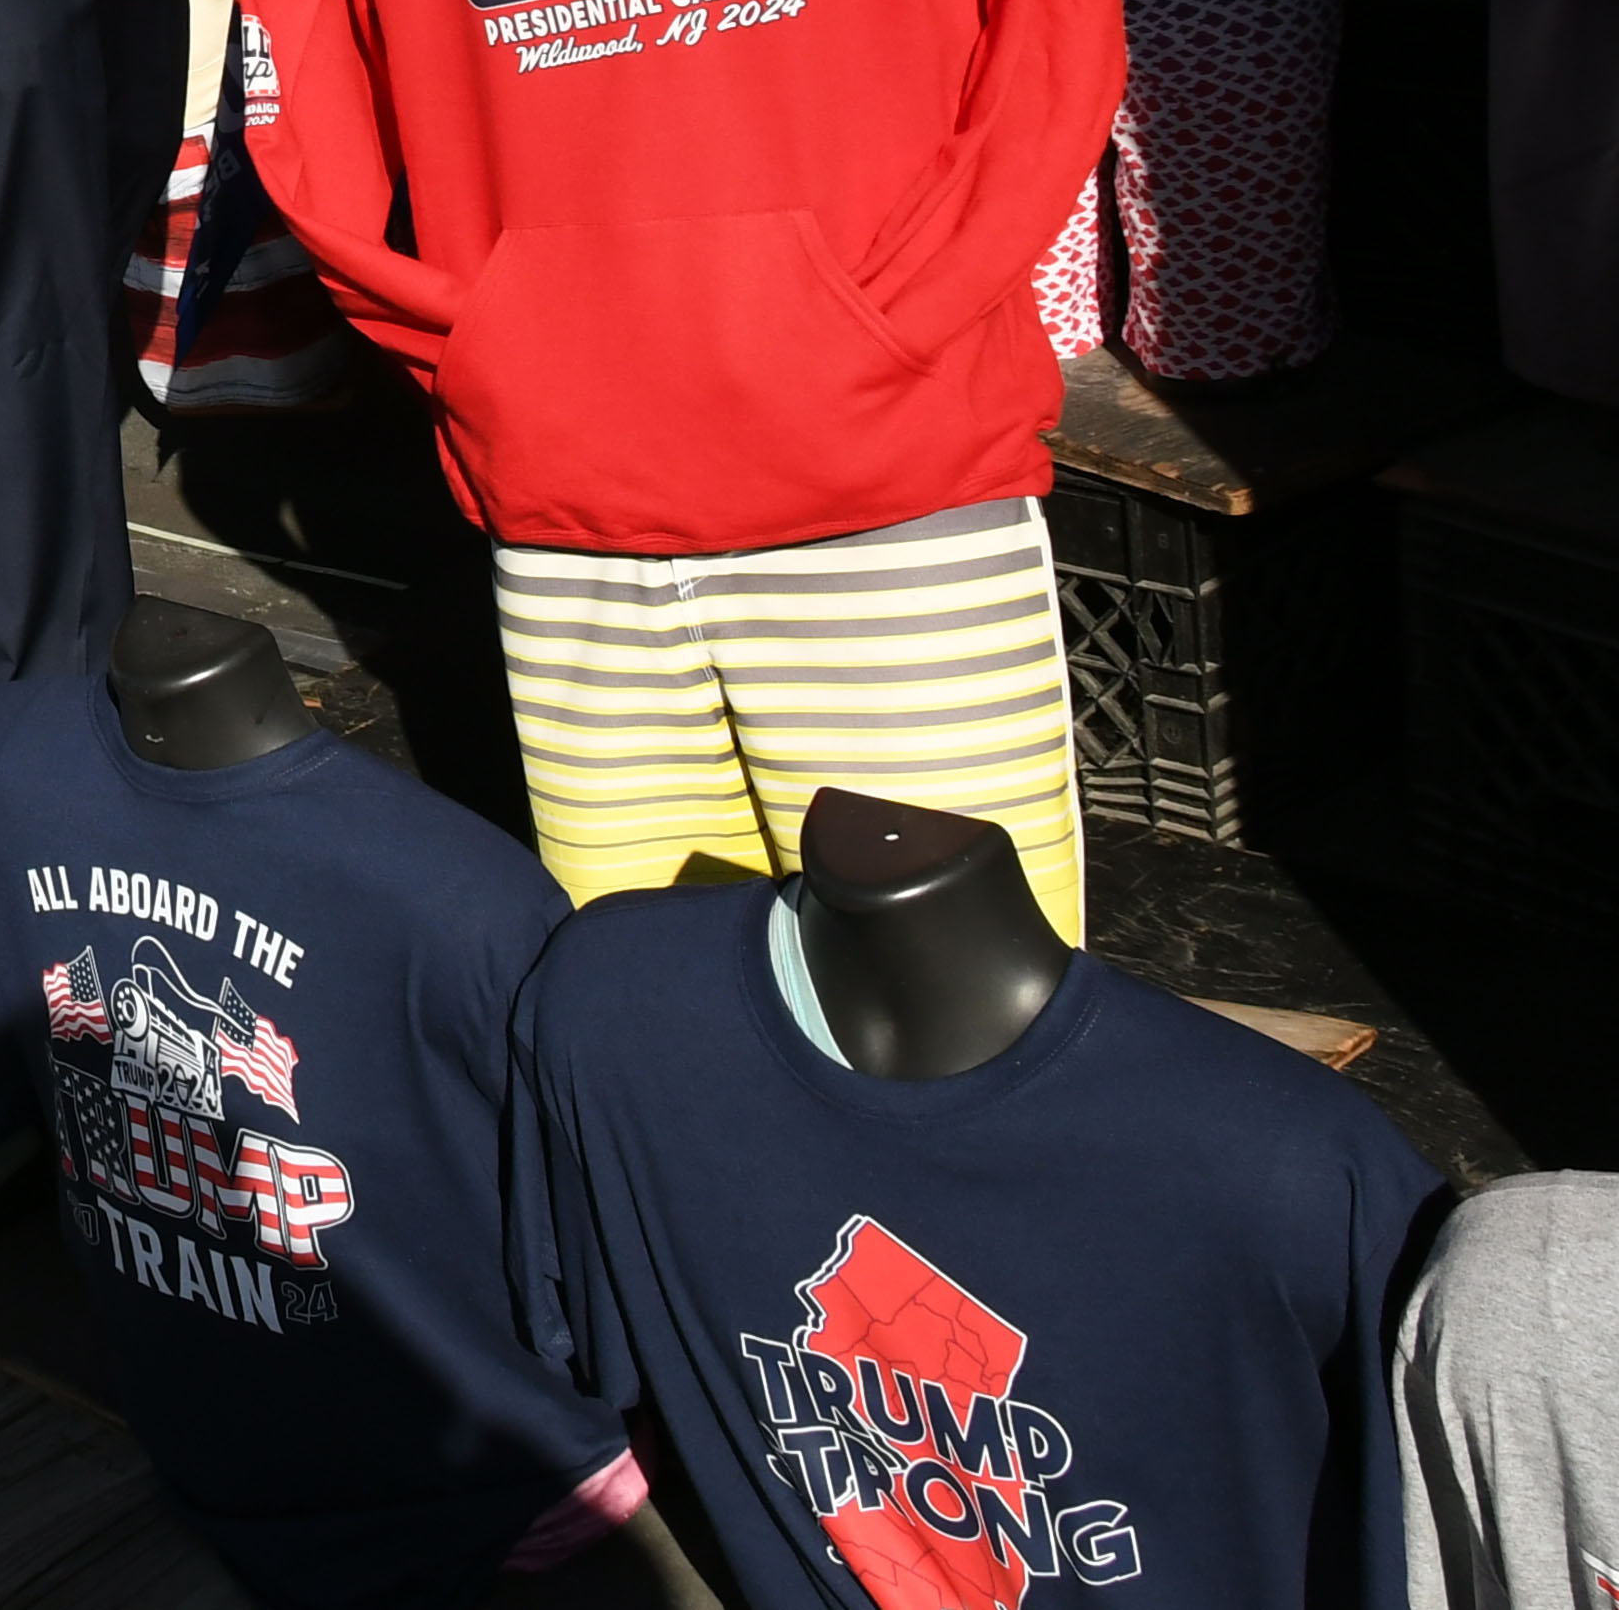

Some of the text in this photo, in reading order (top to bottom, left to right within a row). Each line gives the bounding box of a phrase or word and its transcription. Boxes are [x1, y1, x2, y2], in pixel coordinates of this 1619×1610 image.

[515, 23, 643, 74] Wildwood,
[656, 7, 708, 47] NJ
[26, 865, 306, 990] ALL ABOARD THE
[113, 1059, 219, 1113] TRUMP 2024
[51, 1057, 356, 1272] TRUMP
[96, 1194, 285, 1335] TRAIN
[282, 1280, 339, 1326] 24
[740, 1332, 1074, 1491] TRUMP
[766, 1426, 1143, 1587] TRONG
